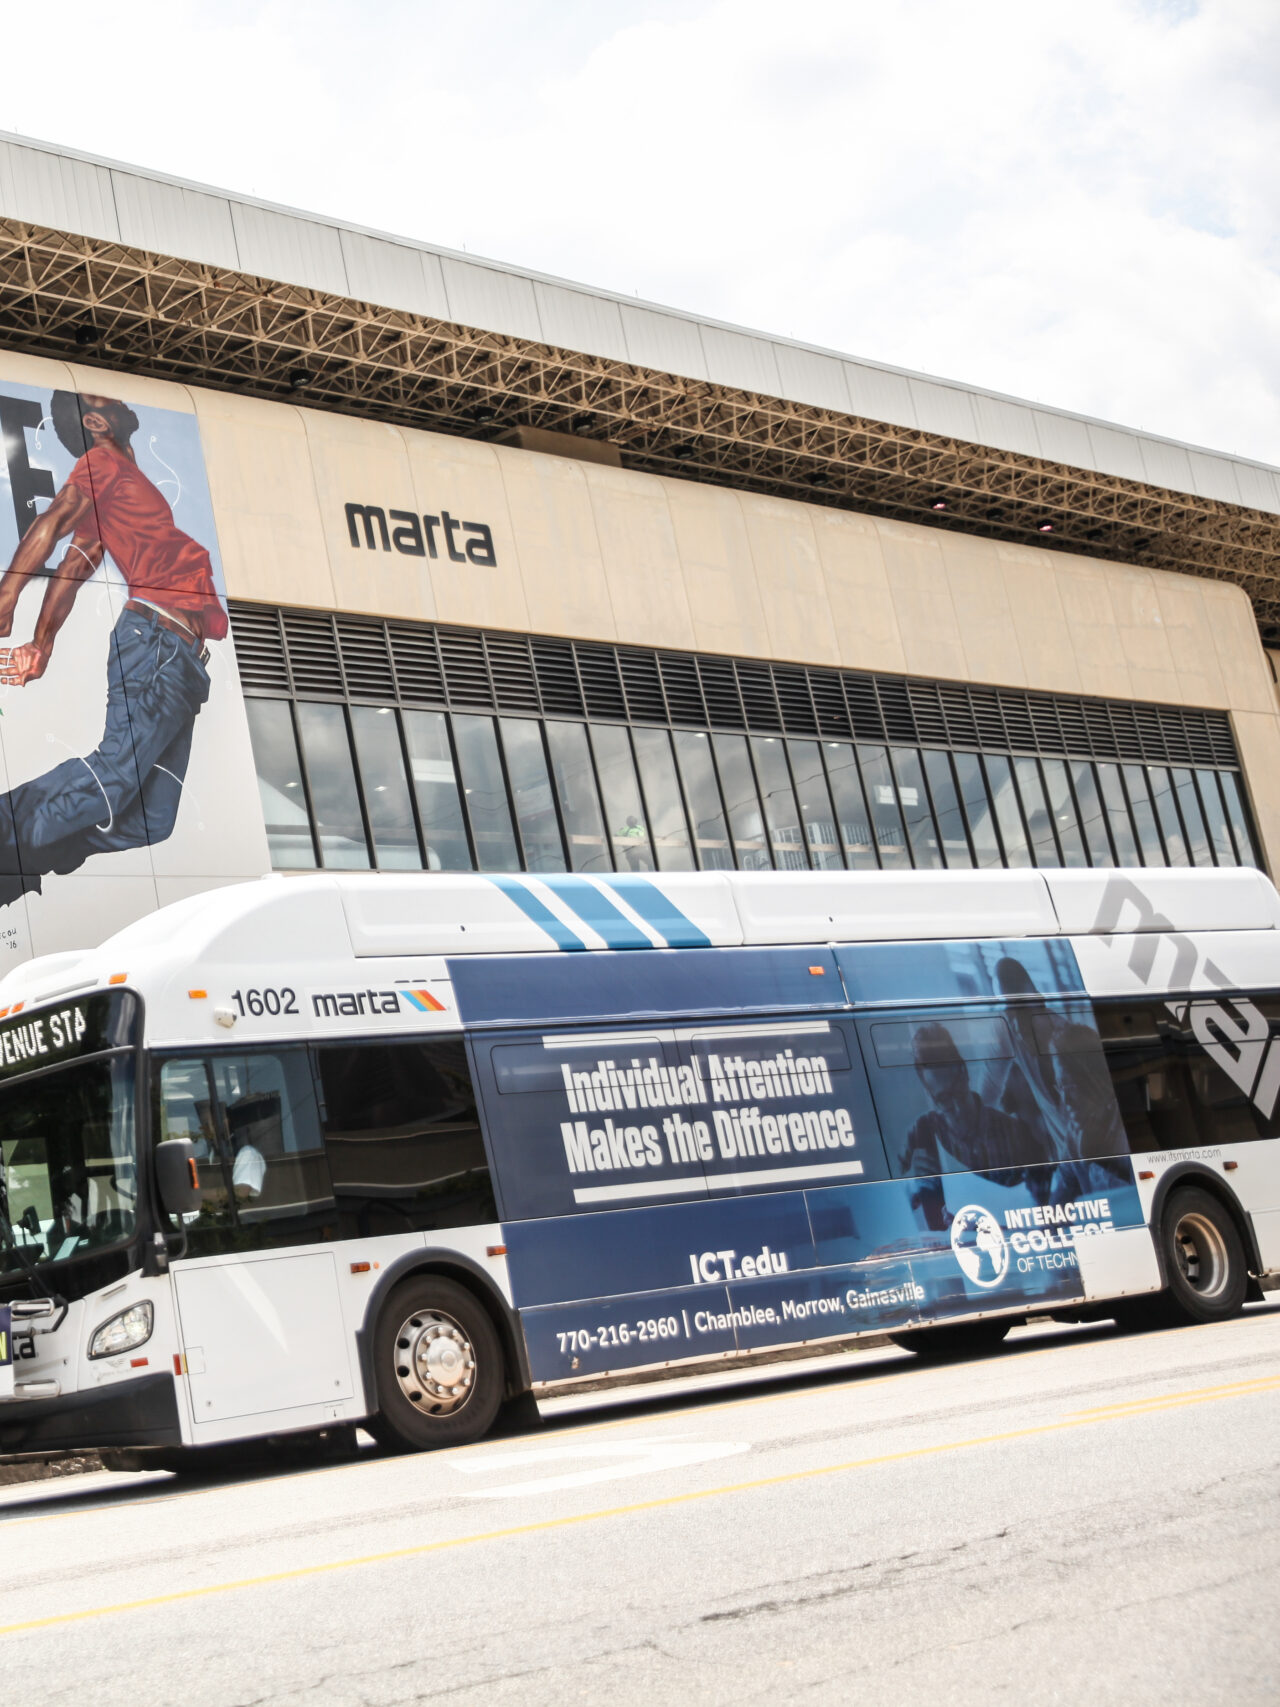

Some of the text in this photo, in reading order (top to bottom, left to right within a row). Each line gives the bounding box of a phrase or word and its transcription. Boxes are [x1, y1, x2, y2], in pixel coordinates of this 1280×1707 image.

[344, 502, 498, 568] marta
[231, 987, 401, 1018] 1602 marta
[560, 1049, 833, 1113] Individual Attention
[560, 1107, 856, 1173] Makes the Difference
[1147, 1149, 1222, 1164] www.itsmarta.com
[1004, 1198, 1111, 1229] INTERACTIVE
[689, 1246, 789, 1284] ICT.edu
[1017, 1256, 1035, 1273] OF
[556, 1316, 678, 1353] 770-216-2960
[694, 1305, 781, 1332] Chamblee,
[781, 1298, 845, 1320] Morrow,
[846, 1282, 925, 1310] Gainesville
